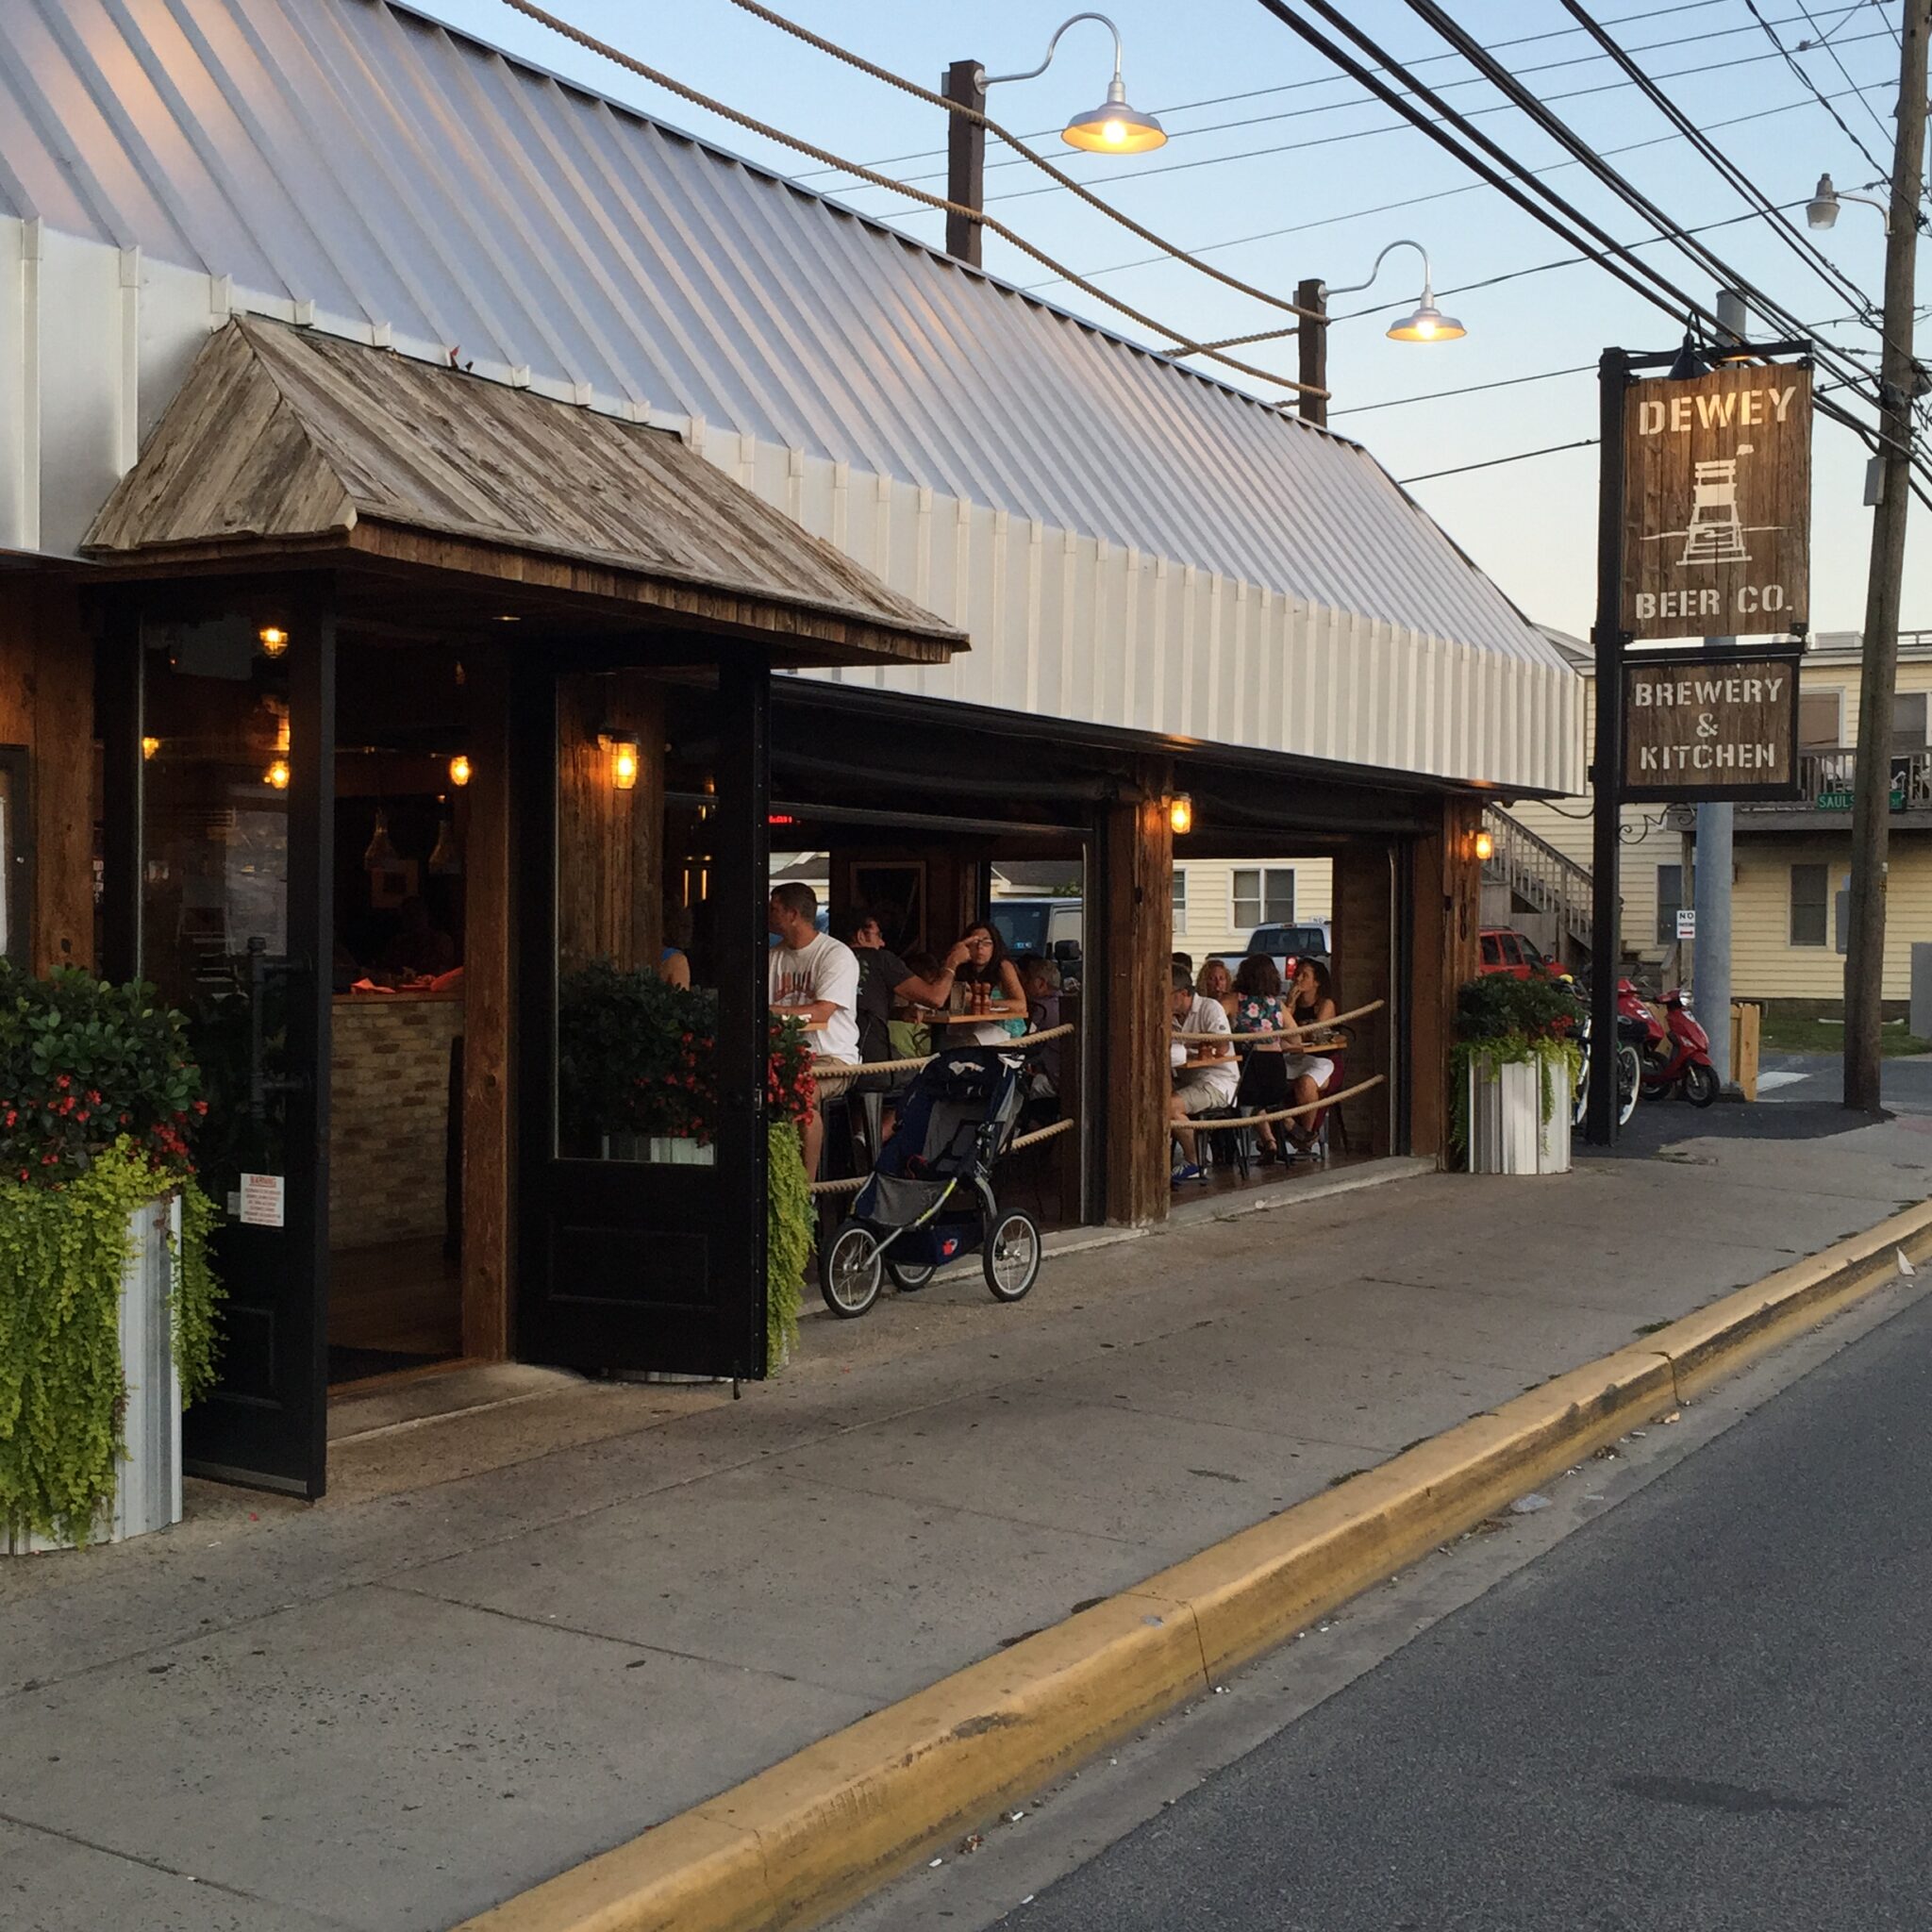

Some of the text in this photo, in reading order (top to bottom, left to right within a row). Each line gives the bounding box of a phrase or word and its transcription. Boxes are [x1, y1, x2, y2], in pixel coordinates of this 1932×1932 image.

[1639, 386, 1796, 435] DEWEY
[1636, 585, 1793, 619] BEER CO.
[1636, 677, 1783, 707] BREWERY
[1696, 713, 1719, 737] &
[1641, 743, 1775, 770] KITCHEN
